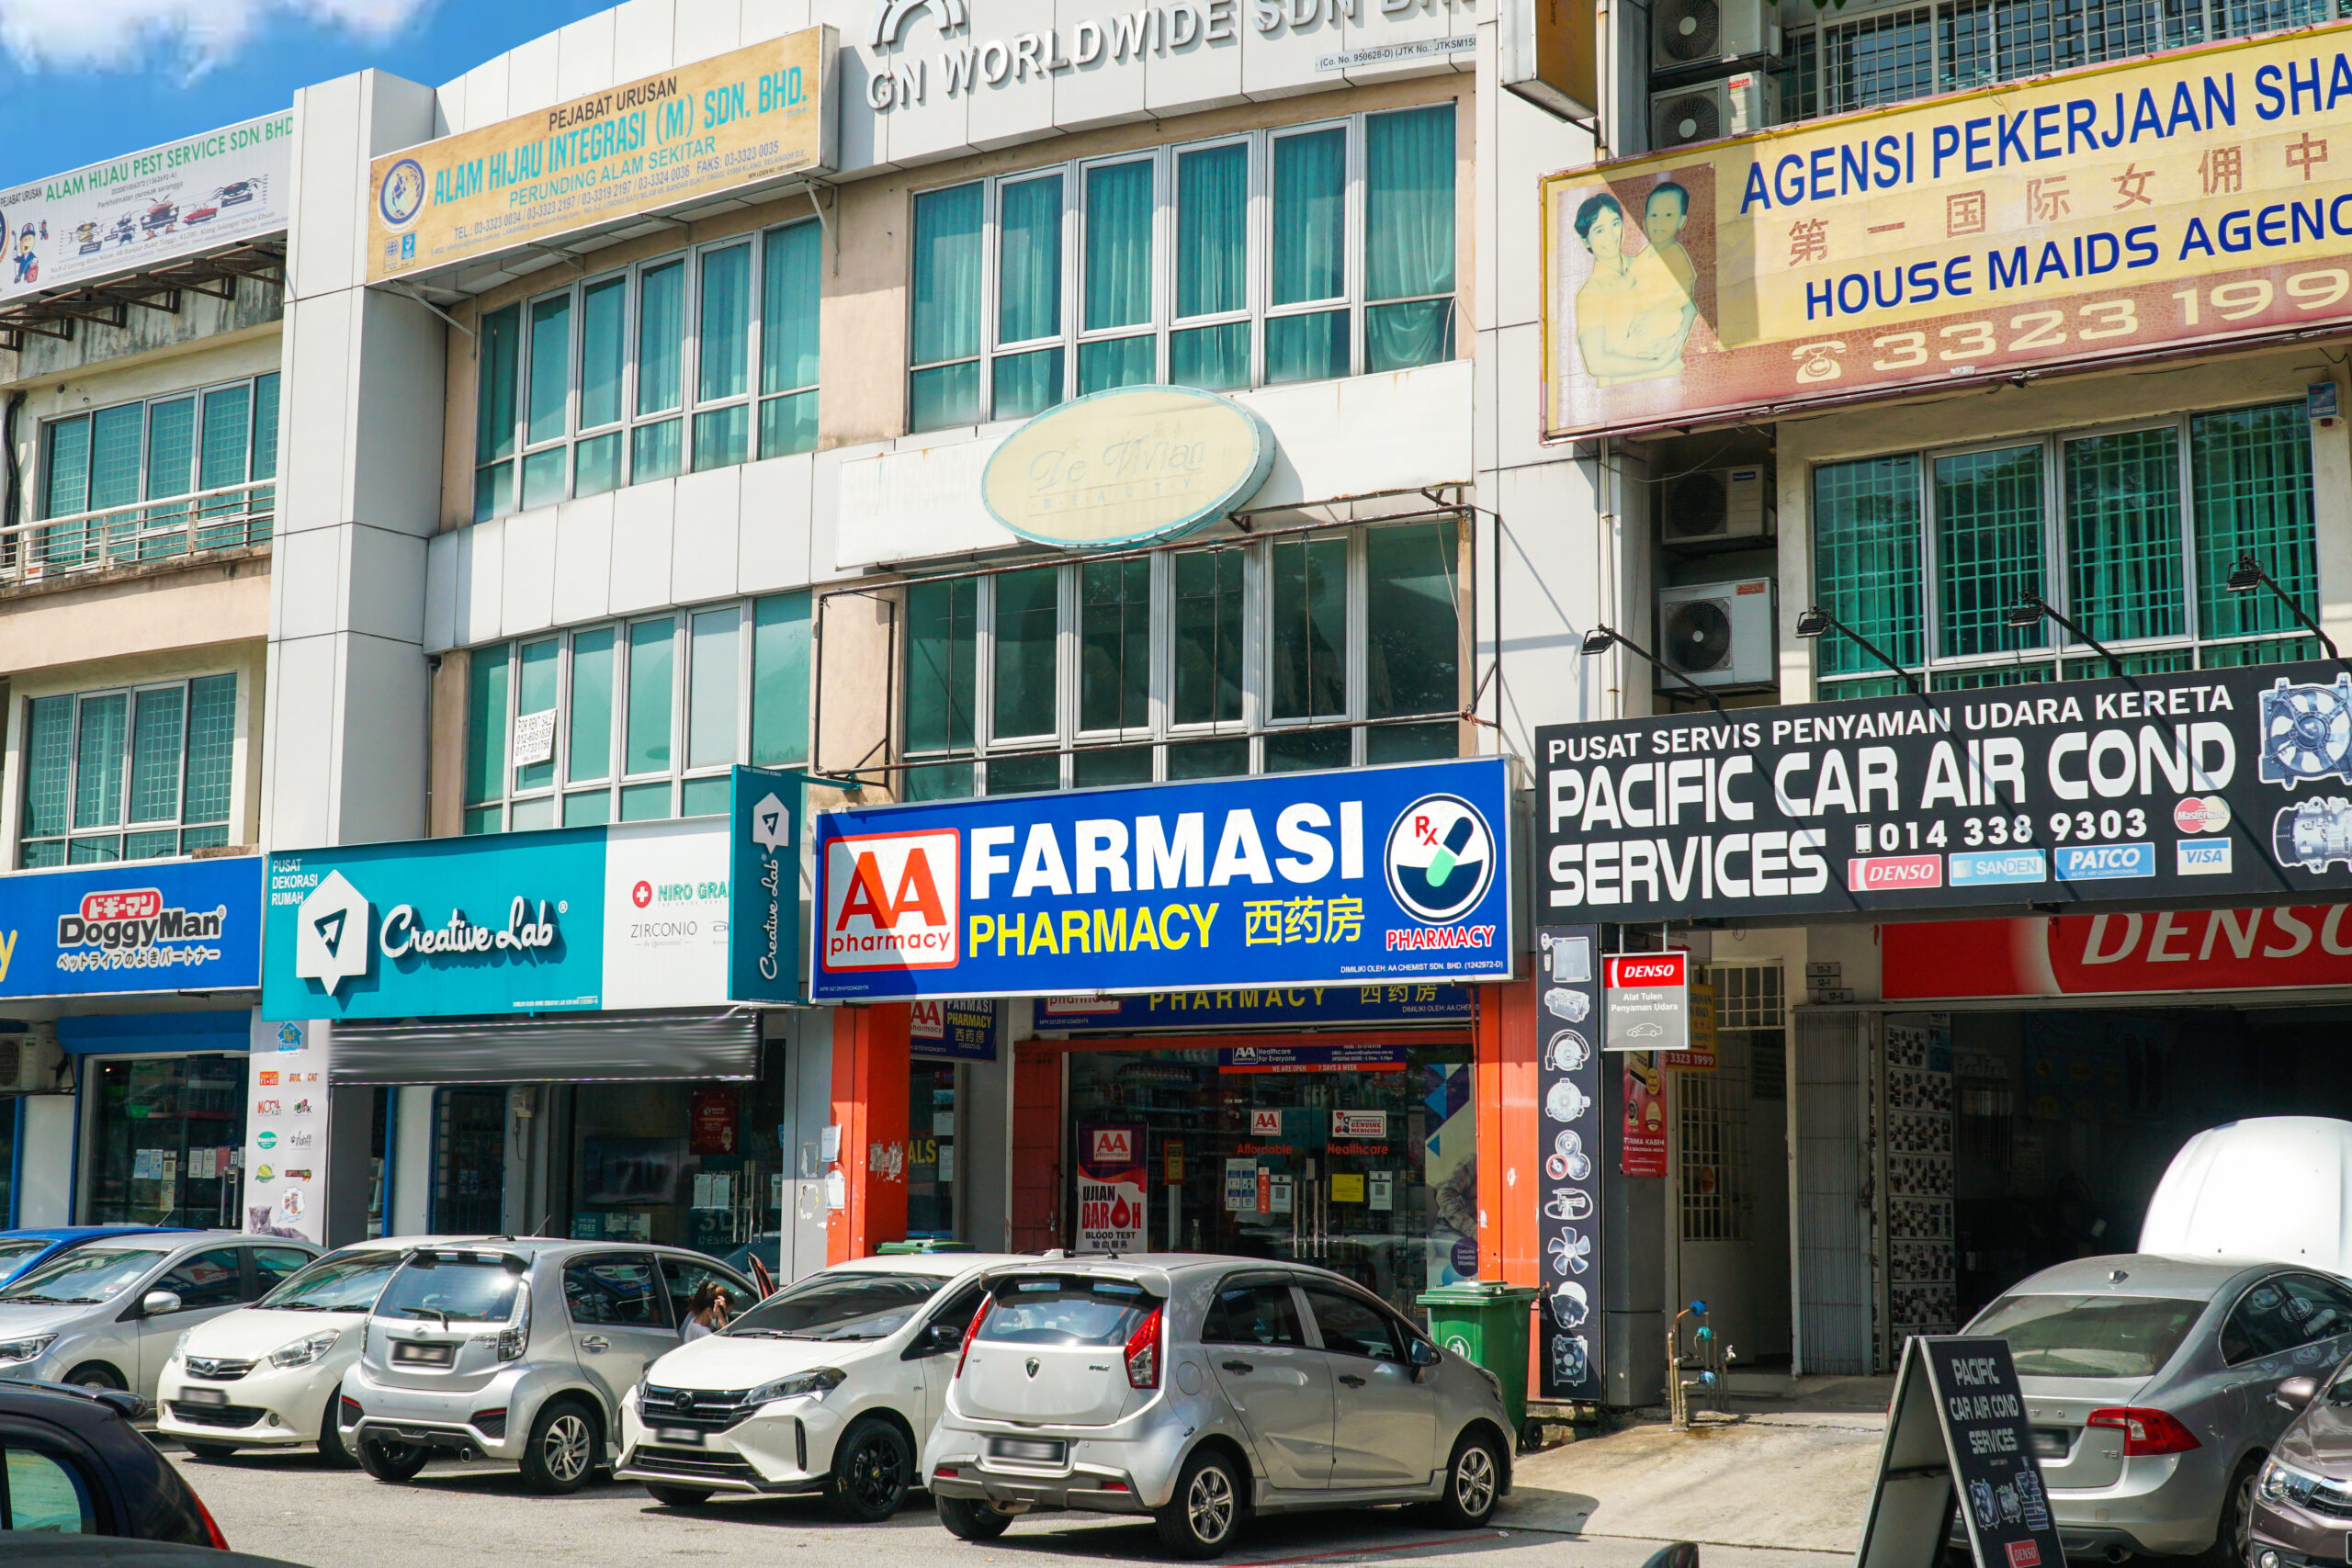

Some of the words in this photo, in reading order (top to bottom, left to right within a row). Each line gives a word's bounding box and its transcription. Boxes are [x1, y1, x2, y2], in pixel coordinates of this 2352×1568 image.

[866, 59, 923, 109] GN
[937, 0, 1231, 93] WORLDWIDE
[1320, 57, 1337, 69] (Co.
[1338, 55, 1351, 66] No.
[1353, 48, 1395, 62] 950628-D)
[1395, 44, 1414, 60] (JTK
[549, 96, 613, 131] PEJABAT
[616, 76, 677, 111] URUSAN
[434, 158, 484, 207] ALAM
[489, 140, 543, 191] HIJAU
[548, 110, 646, 174] INTEGRASI
[656, 93, 694, 145] (M)
[704, 82, 751, 130] SDN.
[758, 65, 808, 114] BHD.
[1740, 132, 1915, 214] AGENSI
[1933, 71, 2237, 179] PEKERJAAN
[2255, 52, 2352, 121] SHA
[46, 175, 85, 203] ALAM
[88, 163, 129, 190] HIJAU
[133, 152, 163, 178] PEST
[167, 135, 226, 169] SERVICE
[231, 125, 262, 152] SDN.
[266, 116, 293, 141] BHD
[510, 168, 596, 209] PERUNDING
[600, 155, 644, 184] ALAM
[648, 136, 715, 170] SEKITAR
[0, 193, 22, 207] PEJABAT
[22, 187, 42, 202] URUSAN
[97, 193, 134, 209] Perkhidmatan
[135, 187, 157, 200] perosak
[474, 216, 503, 234] 03-3323
[503, 211, 521, 227] 0034
[527, 203, 556, 220] 03-3323
[558, 197, 576, 212] 2197
[582, 186, 612, 205] 03-3319
[613, 180, 632, 197] 2197
[638, 170, 669, 190] 03-3324
[671, 164, 690, 181] 0036
[696, 156, 722, 175] FAKS:
[724, 146, 757, 166] 03-3323
[759, 140, 779, 157] 0035
[1788, 132, 2328, 266] 第一国际女佣中
[1806, 254, 1972, 321] HOUSE
[1988, 224, 2158, 290] MAIDS
[2178, 193, 2352, 261] AGENC
[1874, 299, 2138, 371] 3323
[2172, 268, 2351, 326] 199
[1549, 732, 1642, 763] PUSAT
[1652, 723, 1761, 755] SERVIS
[1773, 707, 1951, 745] PENYAMAN
[1964, 696, 2084, 730] UDARA
[2096, 684, 2233, 720] KERETA
[1549, 754, 1754, 833] PACIFIC
[1775, 746, 1899, 817] CAR
[1920, 737, 2026, 809] AIR
[2048, 721, 2236, 800] COND
[2177, 807, 2227, 823] MasterCard
[970, 800, 1364, 900] FARMASI
[1549, 829, 1828, 908] SERVICES
[1879, 819, 1947, 852] 014
[1963, 814, 2033, 846] 338
[2049, 808, 2147, 841] 9303
[273, 859, 302, 873] PUSAT
[762, 859, 779, 897] Lab
[1869, 863, 1934, 883] DENSO
[1975, 857, 2040, 876] SANDEN
[2069, 848, 2141, 870] PATCO
[2185, 850, 2223, 863] VISA
[272, 874, 318, 890] DEKORASI
[658, 883, 693, 902] NIRO
[698, 881, 729, 899] GRA
[835, 847, 947, 931] AA
[88, 895, 154, 919] ドギーマン
[271, 891, 304, 907] RUMAH
[59, 910, 220, 950] DoggyMan
[379, 904, 495, 958] Creative
[496, 896, 553, 951] Lab
[631, 920, 697, 938] ZIRCONIO
[969, 902, 1220, 958] PHARMACY
[1243, 893, 1365, 947] 西药房
[760, 900, 779, 979] Creative
[831, 931, 951, 956] pharmacy
[1385, 925, 1497, 952] PHARMACY
[1340, 964, 1366, 974] DIMILIKI
[1367, 964, 1386, 973] OLEH:
[1387, 964, 1397, 972] AA
[1398, 963, 1428, 972] CHEMIST
[1430, 962, 1446, 971] SDN.
[1447, 962, 1464, 970] BHD.
[1464, 960, 1504, 972] (1242972-D)
[1624, 964, 1674, 978] DENSO
[947, 999, 992, 1013] FARMASI
[1149, 987, 1326, 1010] PHARMACY
[1611, 1004, 1652, 1013] Penyaman
[1654, 1002, 1678, 1011] Udara
[1623, 993, 1639, 1001] Alat
[1641, 992, 1663, 1001] Tulen
[911, 1001, 942, 1027] AA
[946, 1012, 992, 1029] PHARMACY
[1269, 1055, 1296, 1063] Everyone
[1670, 1053, 1690, 1064] 3323
[1693, 1054, 1714, 1066] 1999
[1255, 1113, 1278, 1127] AA
[1097, 1134, 1127, 1152] AA
[1237, 1144, 1293, 1155] Affordable
[1327, 1143, 1388, 1155] Healthcare
[1082, 1186, 1115, 1201] UJIAN
[1085, 1231, 1114, 1239] BLOOD
[1116, 1231, 1136, 1239] TEST
[1951, 1358, 2000, 1386] PACIFIC
[1950, 1396, 1973, 1421] CAR
[1974, 1395, 1992, 1419] AIR
[1991, 1393, 2019, 1418] COND
[1969, 1427, 2018, 1454] SERVICES
[2014, 1546, 2036, 1562] DENSO
